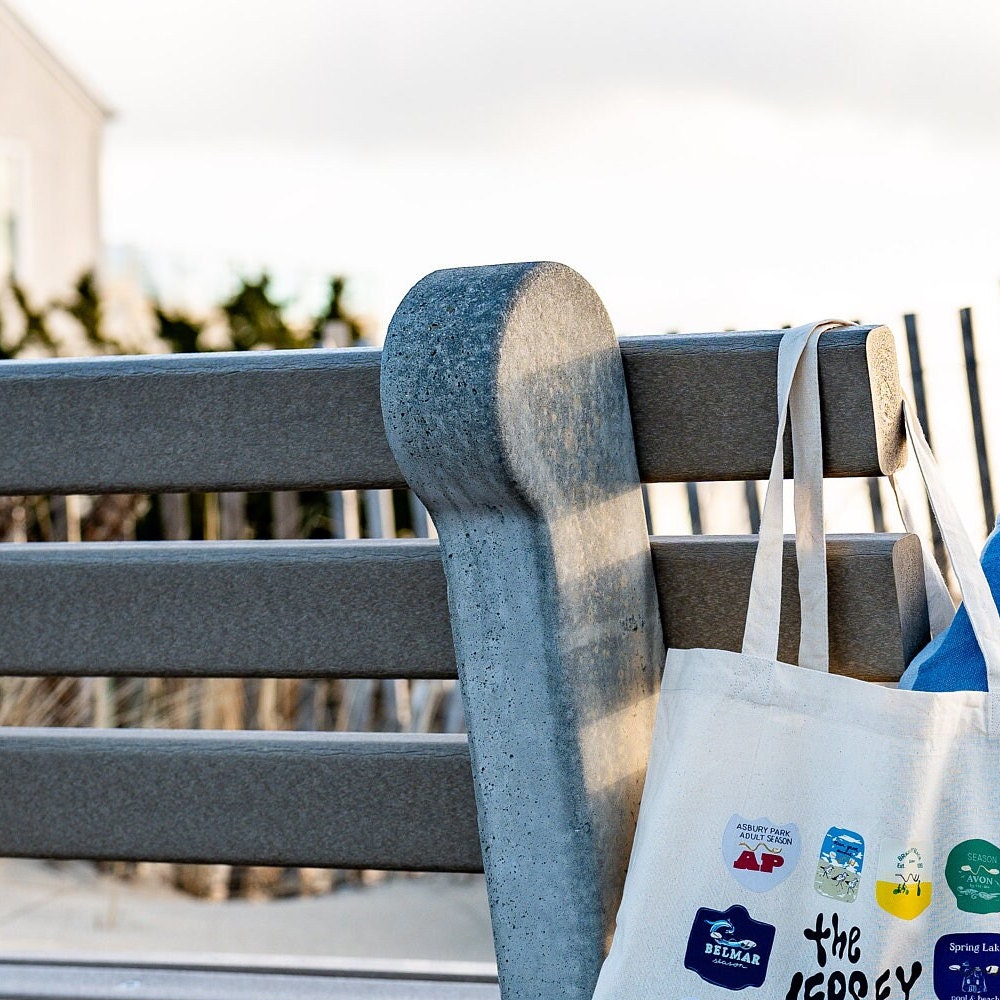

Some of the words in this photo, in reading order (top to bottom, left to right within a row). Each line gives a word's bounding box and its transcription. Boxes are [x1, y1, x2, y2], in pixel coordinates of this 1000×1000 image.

[736, 823, 768, 834] ASBURY
[770, 827, 791, 837] PARK
[739, 832, 765, 841] ADULT
[767, 835, 792, 846] SEASON
[733, 850, 784, 874] AP
[968, 852, 997, 863] SEASON
[967, 875, 993, 885] AVON
[804, 913, 860, 967] the
[704, 943, 761, 966] BELMAR
[949, 942, 980, 954] Spring
